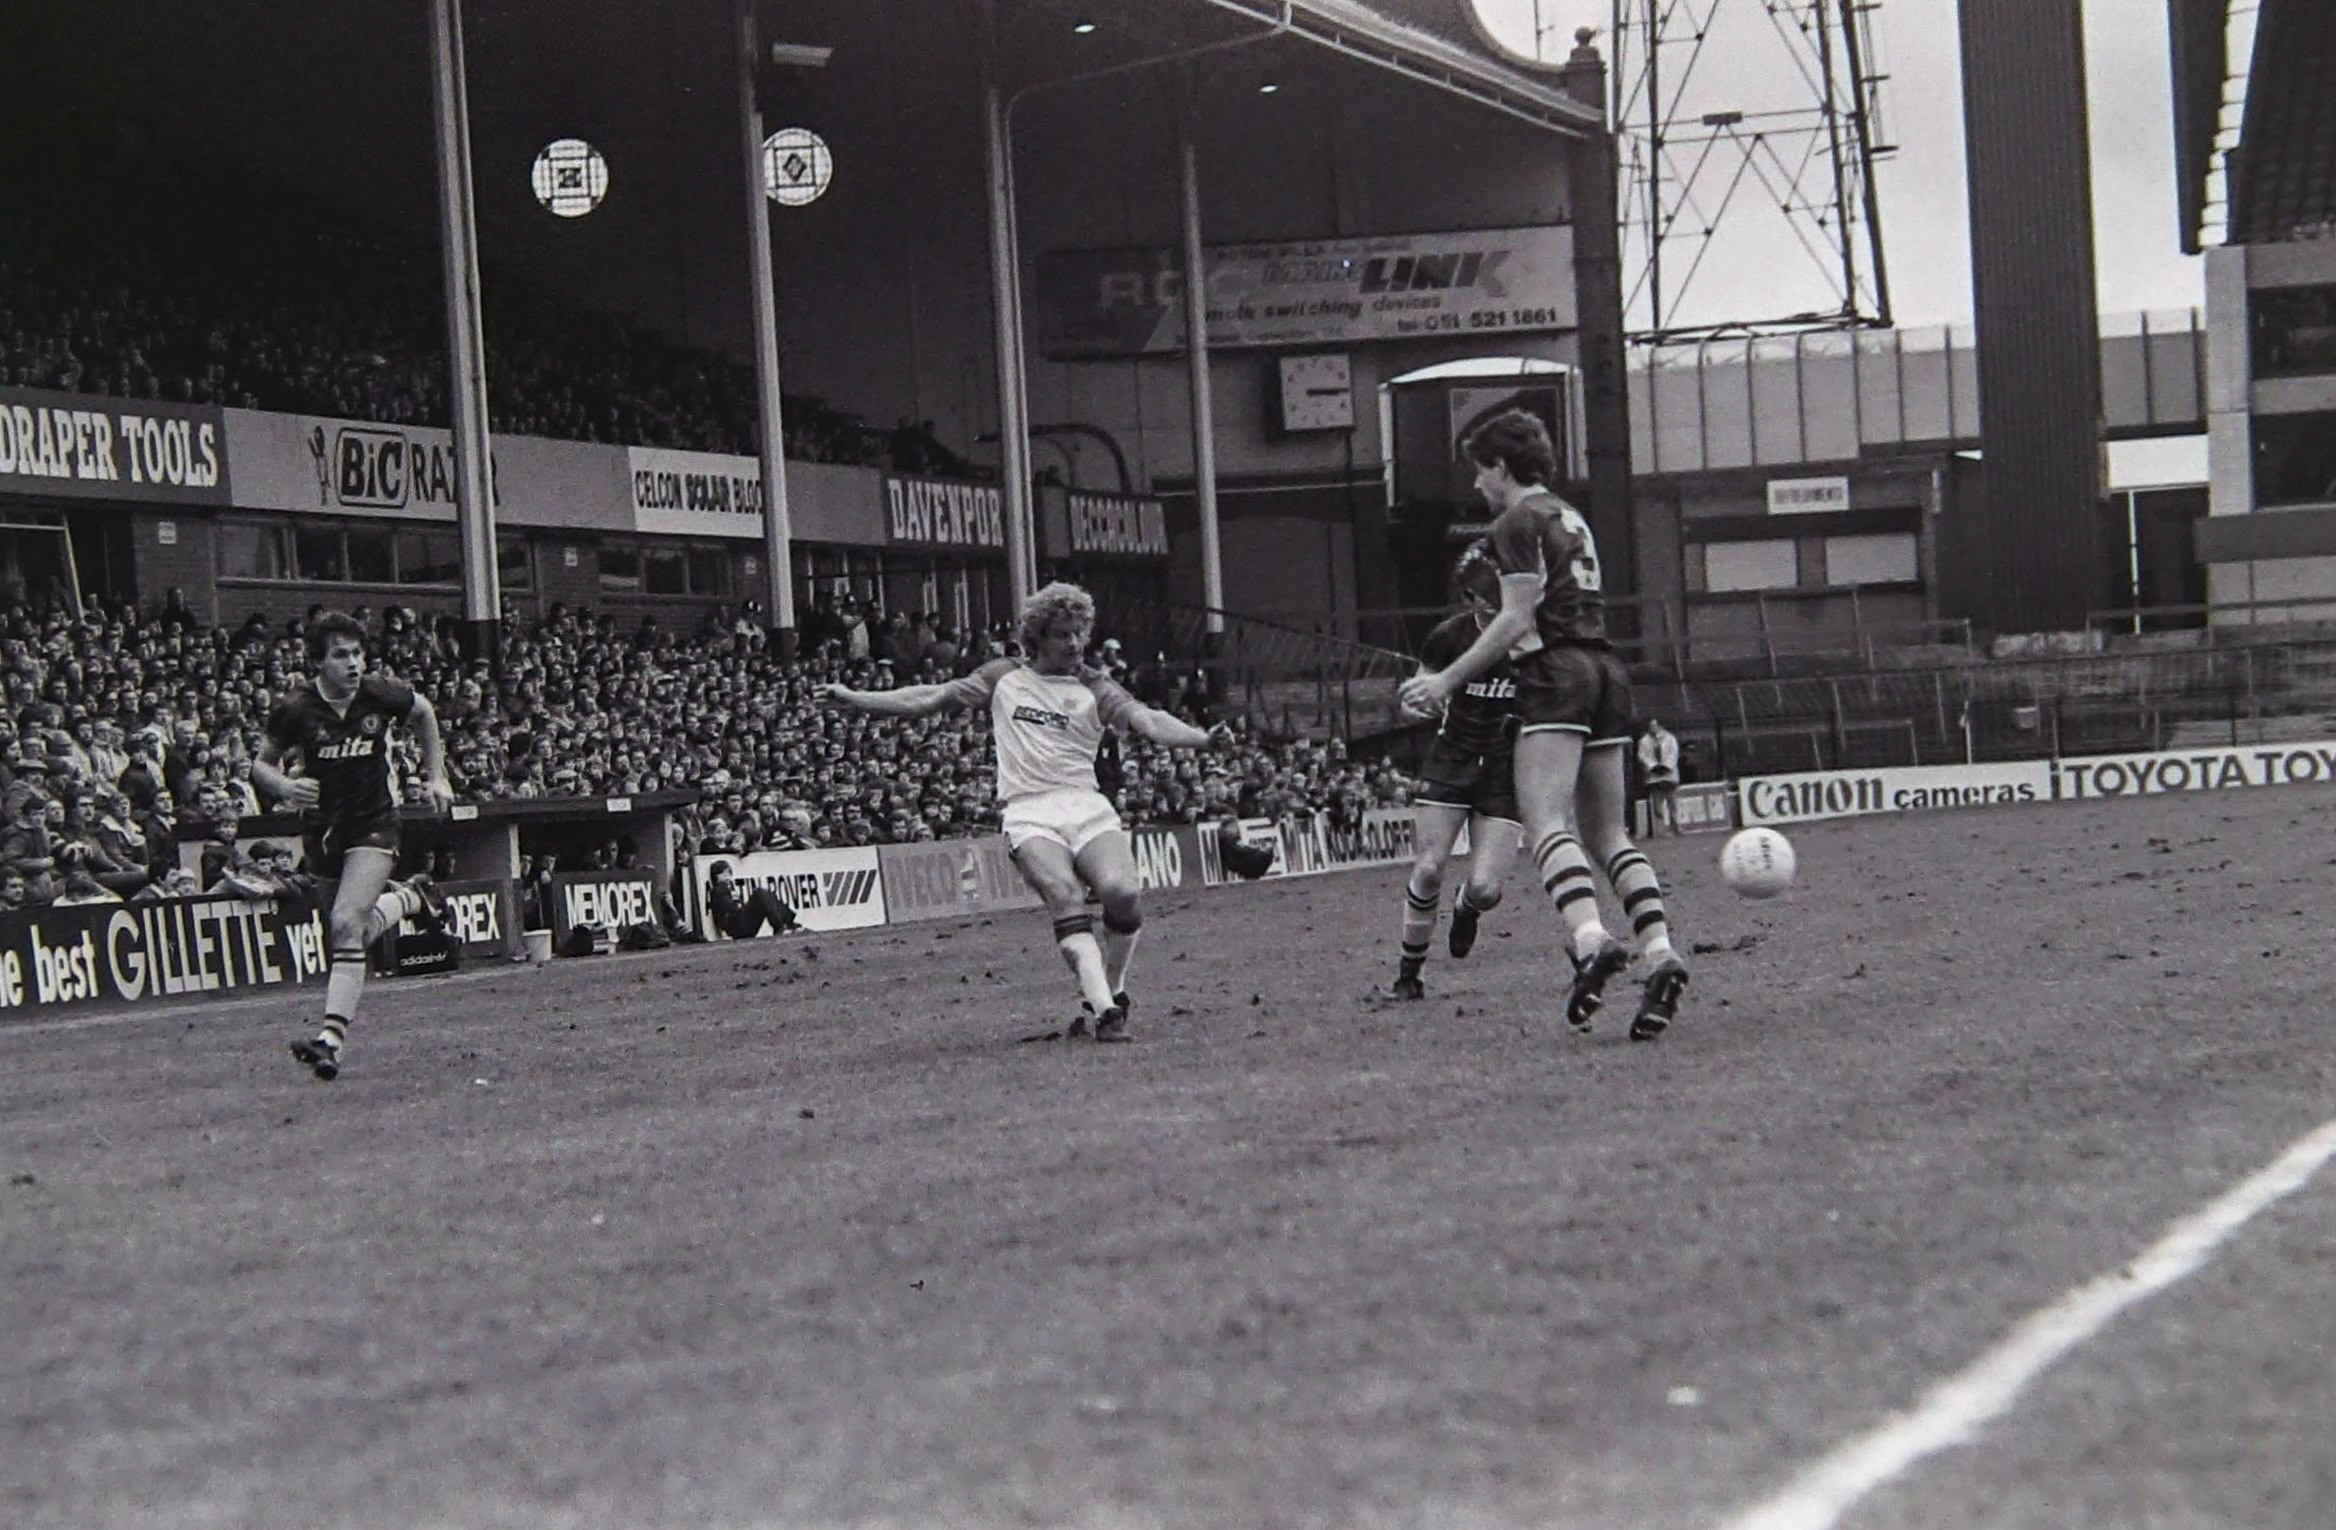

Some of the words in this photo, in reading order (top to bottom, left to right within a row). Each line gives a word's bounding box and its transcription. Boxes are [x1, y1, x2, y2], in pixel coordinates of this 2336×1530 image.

[1265, 300, 1363, 321] switching
[0, 405, 118, 482] DRAPER
[121, 415, 218, 488] TOOLS
[888, 479, 1004, 547] DAVENPOR
[1465, 678, 1517, 699] mita
[317, 736, 375, 760] mita
[1748, 775, 1883, 820] Canon
[1893, 778, 2035, 809] cameras
[2065, 753, 2250, 800] TOYOTA
[1136, 830, 1182, 889] ANO
[564, 880, 657, 928] MEMOREX
[30, 925, 99, 1004] best
[107, 899, 283, 1001] GILLETTE
[285, 909, 326, 983] yet
